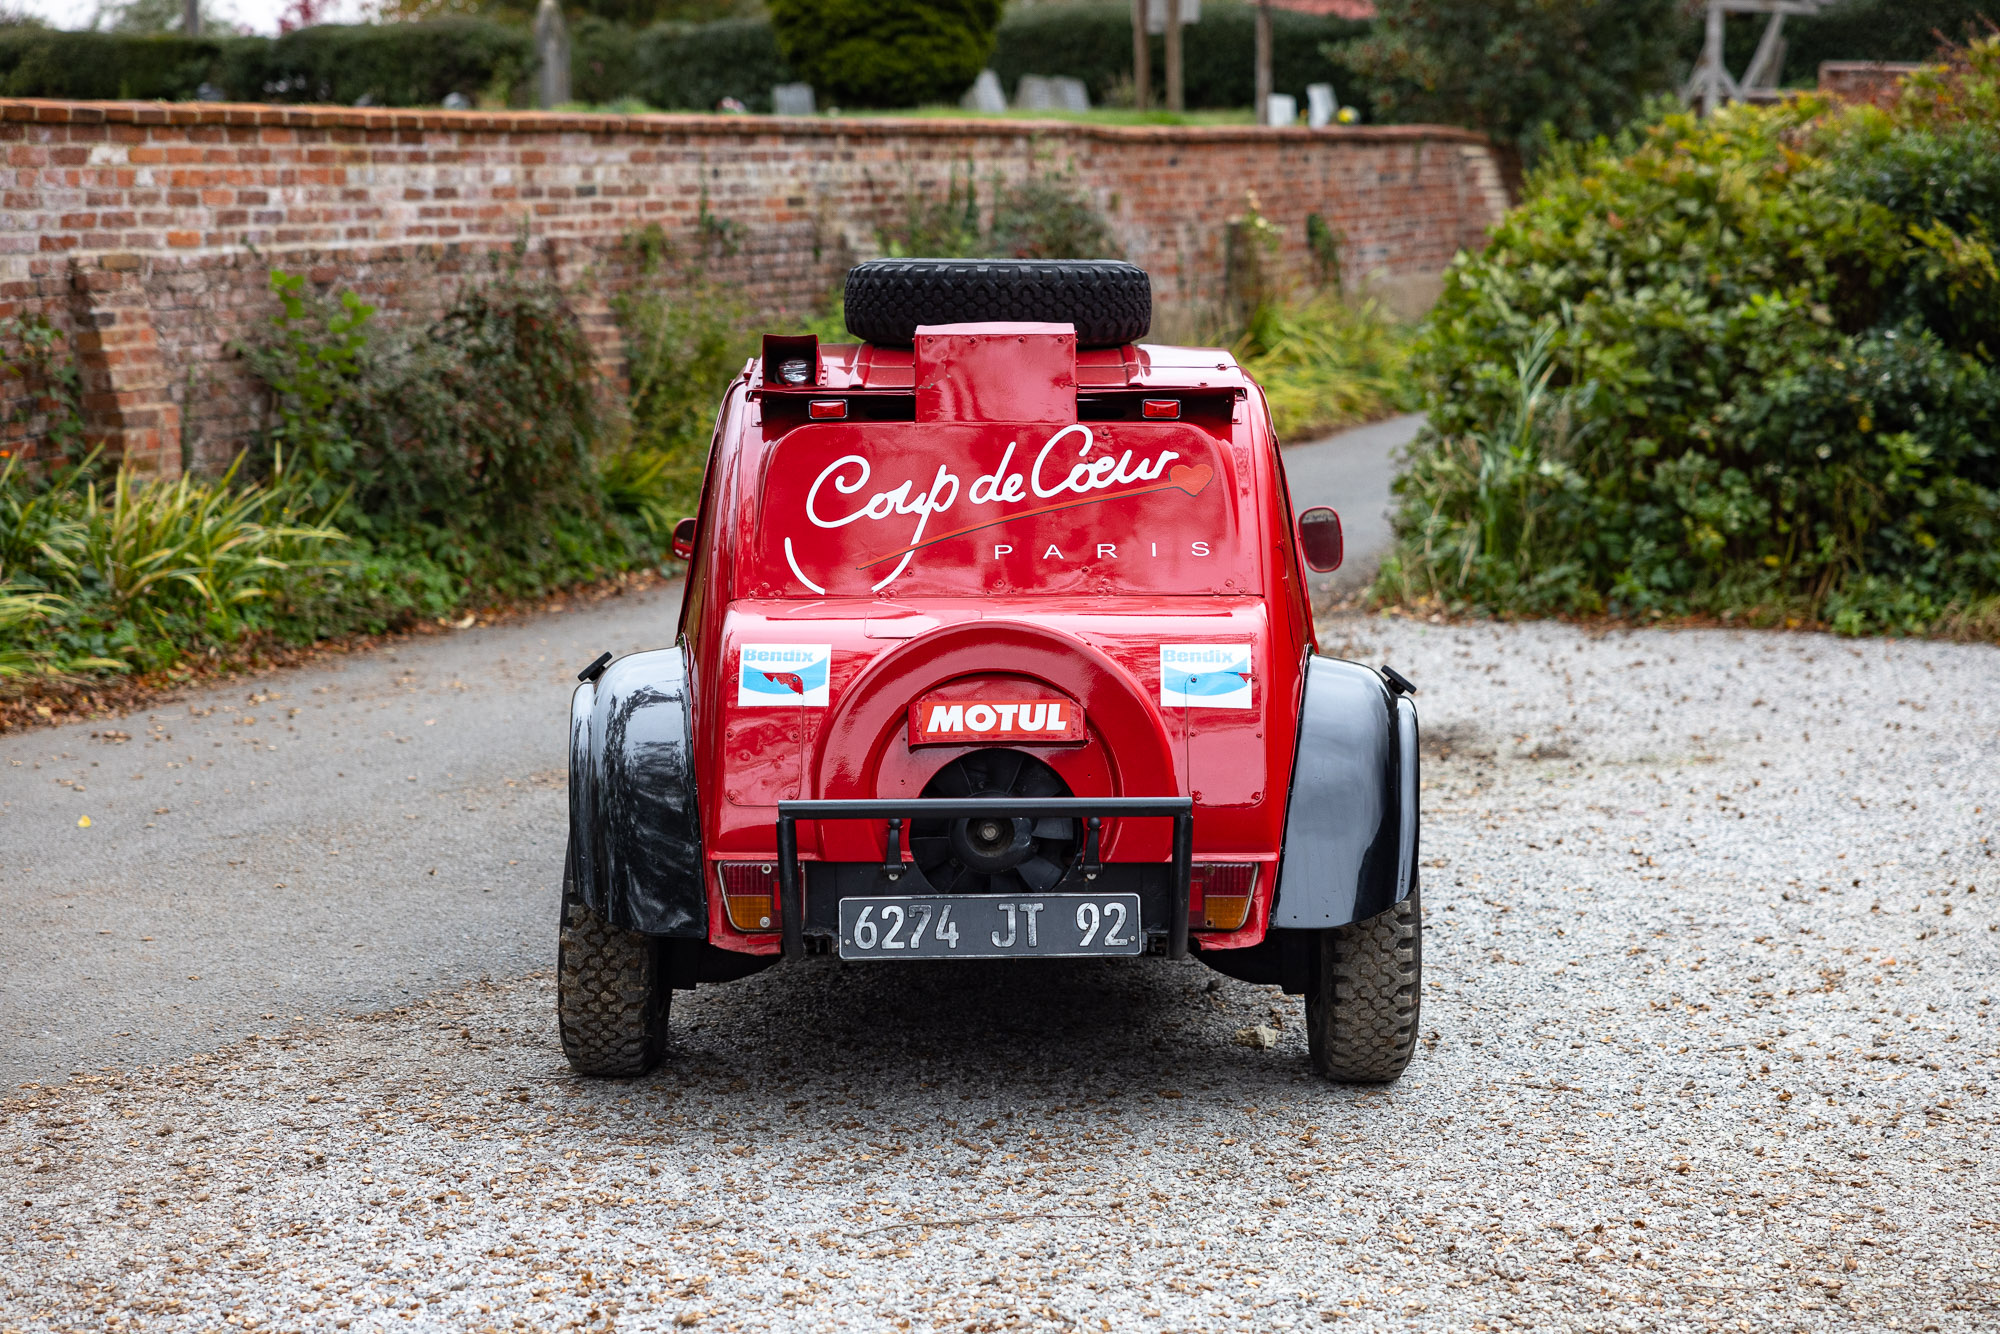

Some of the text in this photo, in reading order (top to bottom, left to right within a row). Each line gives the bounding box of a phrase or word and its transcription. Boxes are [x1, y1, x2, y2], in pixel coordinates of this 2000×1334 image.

[806, 454, 959, 592] Coup
[968, 441, 1026, 505] de
[994, 541, 1210, 560] PARIS
[743, 648, 814, 662] Bendix
[1163, 649, 1234, 663] Bendix
[926, 703, 1067, 733] MOTUL
[853, 902, 1128, 950] 6274 JT 92
